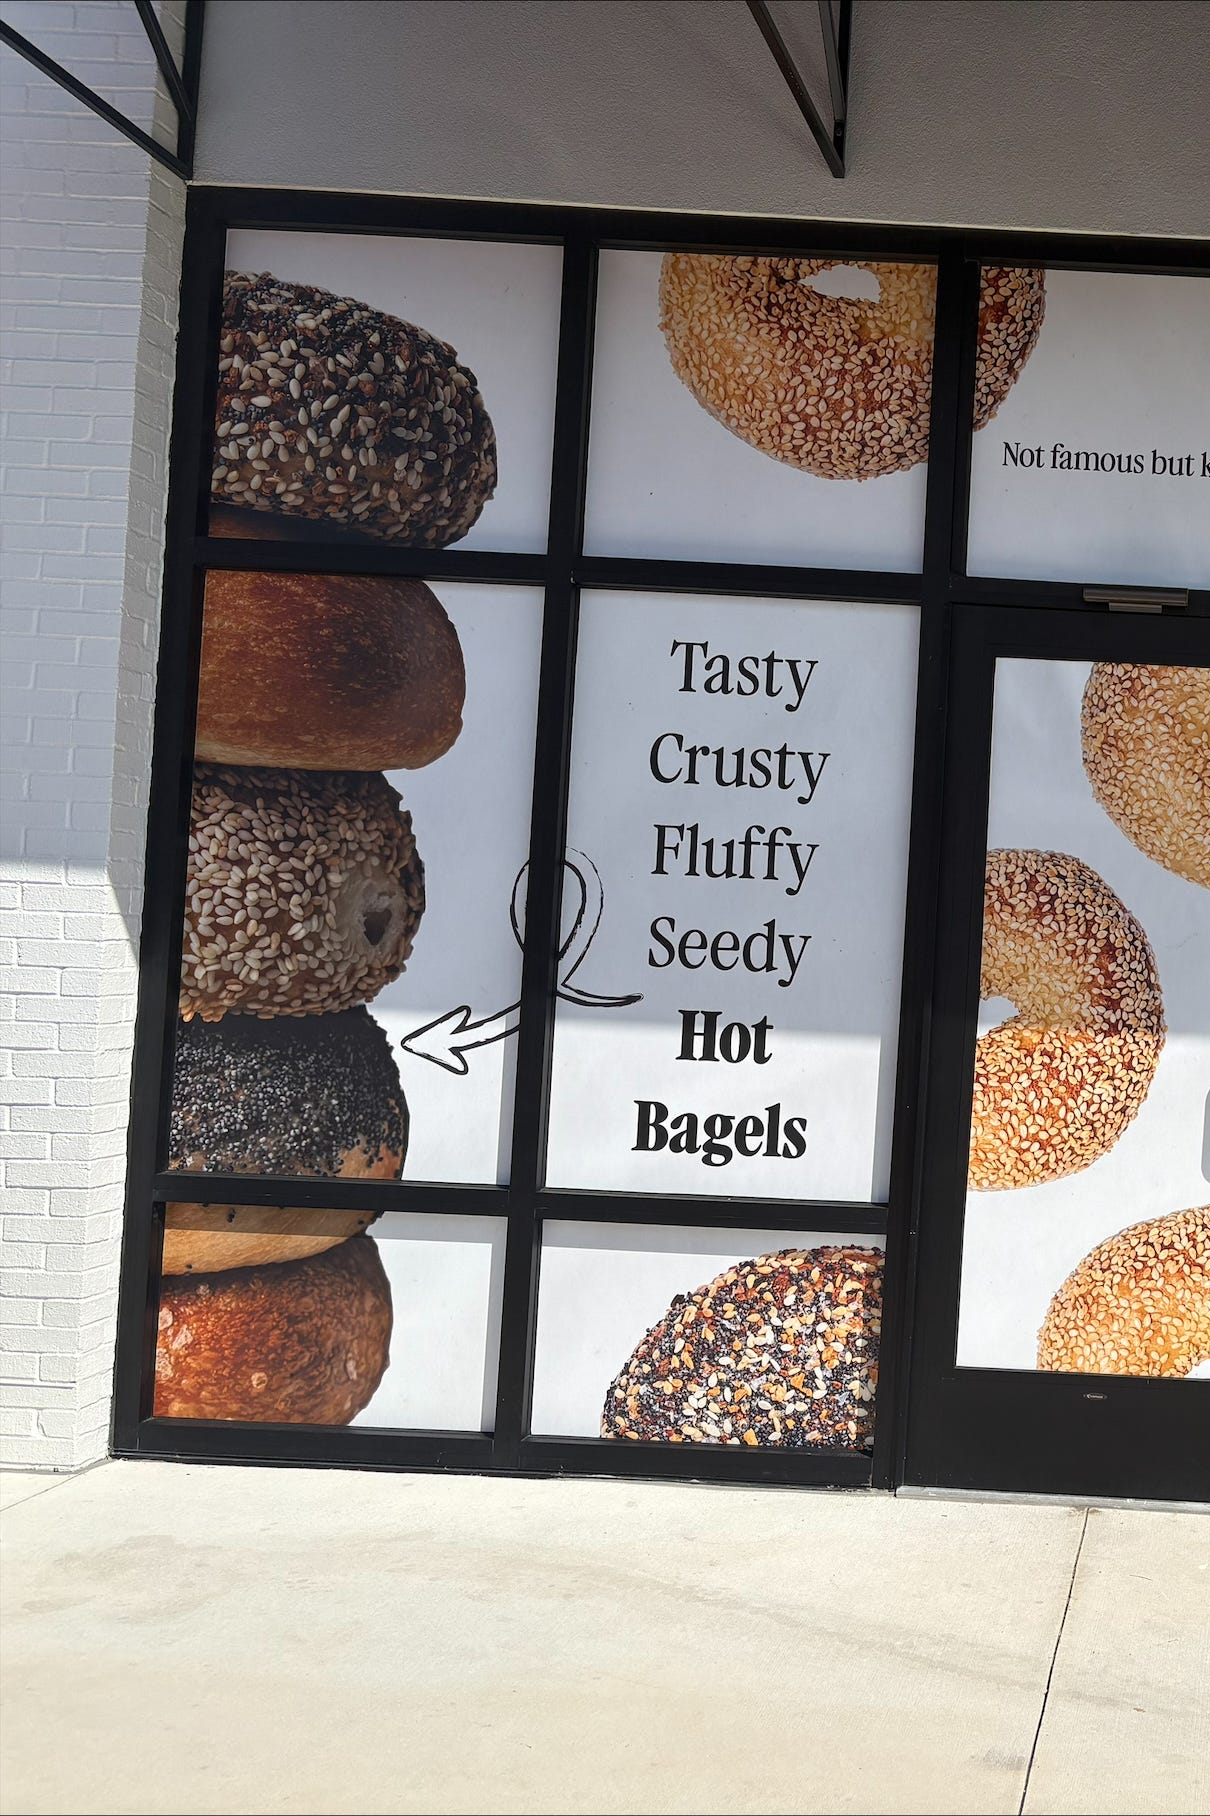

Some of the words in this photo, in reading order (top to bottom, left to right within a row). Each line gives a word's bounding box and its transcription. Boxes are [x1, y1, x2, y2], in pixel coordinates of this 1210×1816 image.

[1002, 441, 1045, 469] Not
[1050, 443, 1145, 475] famous
[1151, 449, 1195, 477] but
[670, 639, 818, 712] Tasty
[649, 733, 830, 805] Crusty
[650, 823, 819, 896] Fluffy
[647, 916, 812, 987] Seedy
[675, 1009, 775, 1065] Hot
[631, 1099, 807, 1167] Bagels
